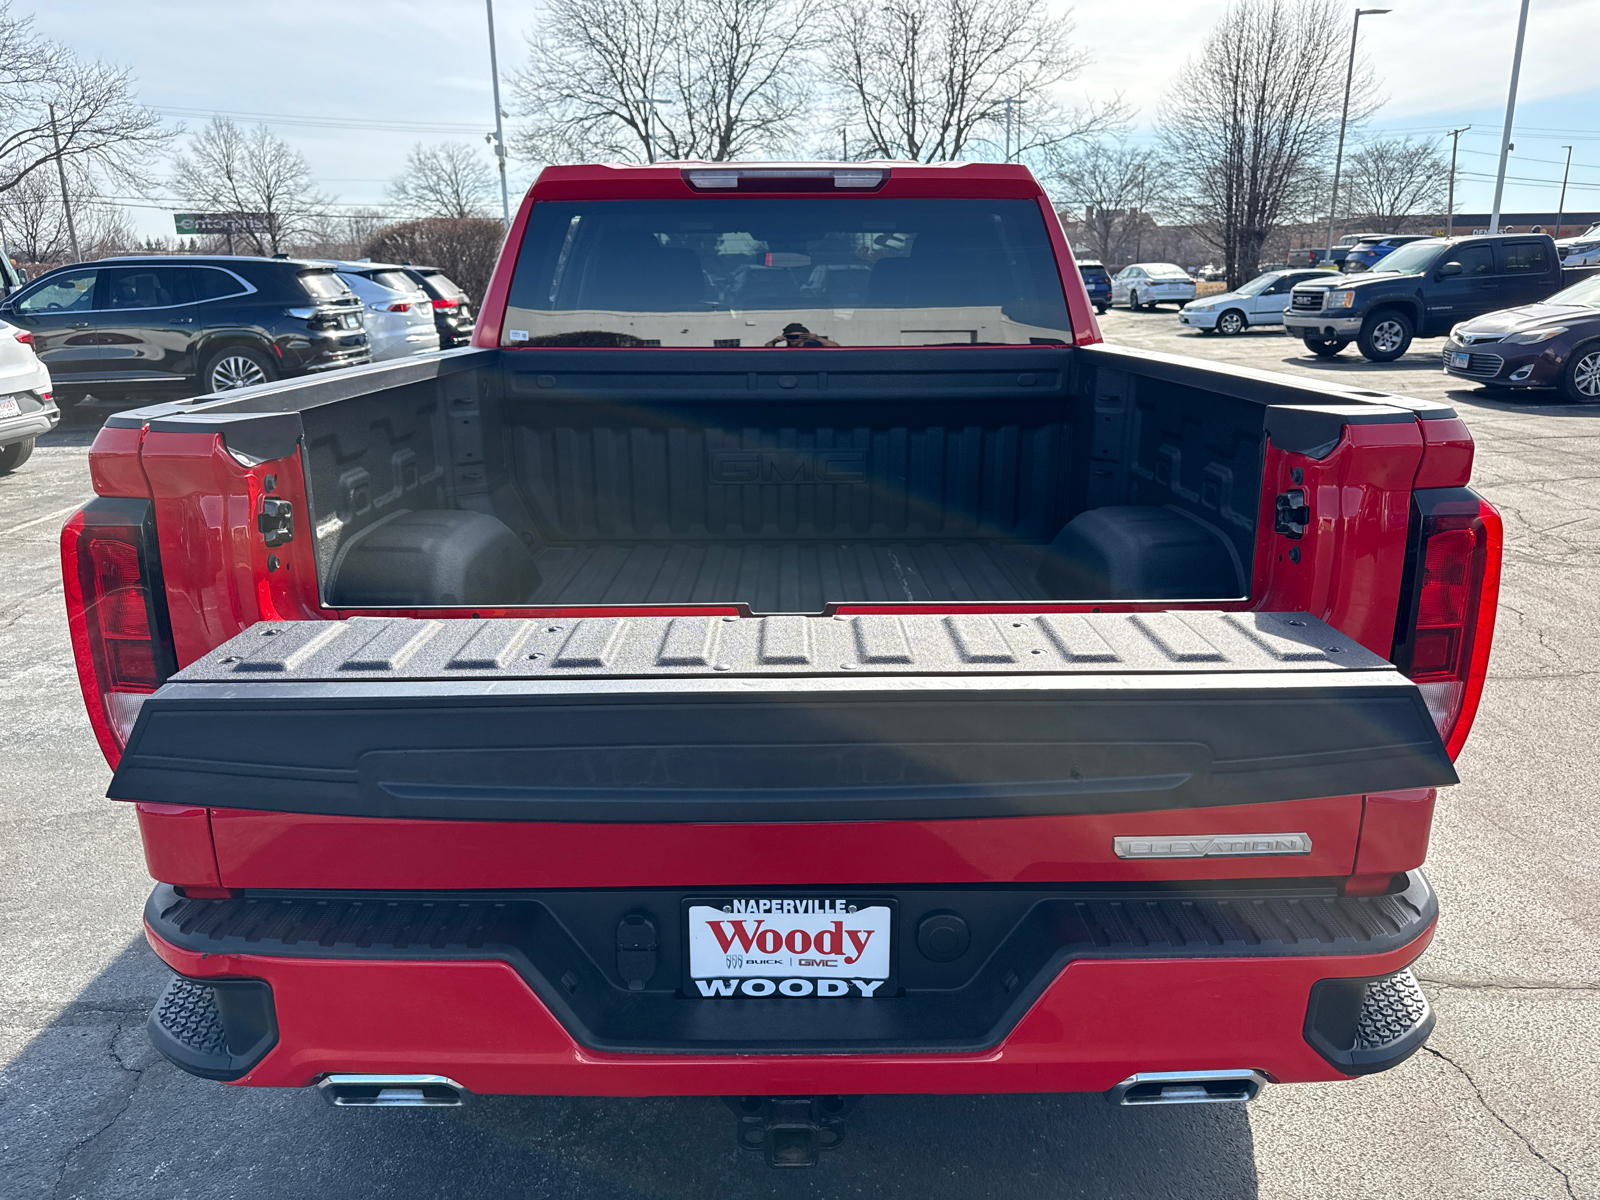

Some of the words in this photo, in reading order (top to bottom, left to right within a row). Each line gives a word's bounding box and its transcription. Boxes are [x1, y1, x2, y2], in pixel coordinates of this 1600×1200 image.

[711, 452, 865, 482] GMC
[1129, 839, 1297, 853] ELEVATION
[733, 900, 846, 913] NAPERVILLE
[705, 920, 875, 964] Woody
[799, 958, 838, 967] GMC
[695, 979, 884, 997] WOODY
